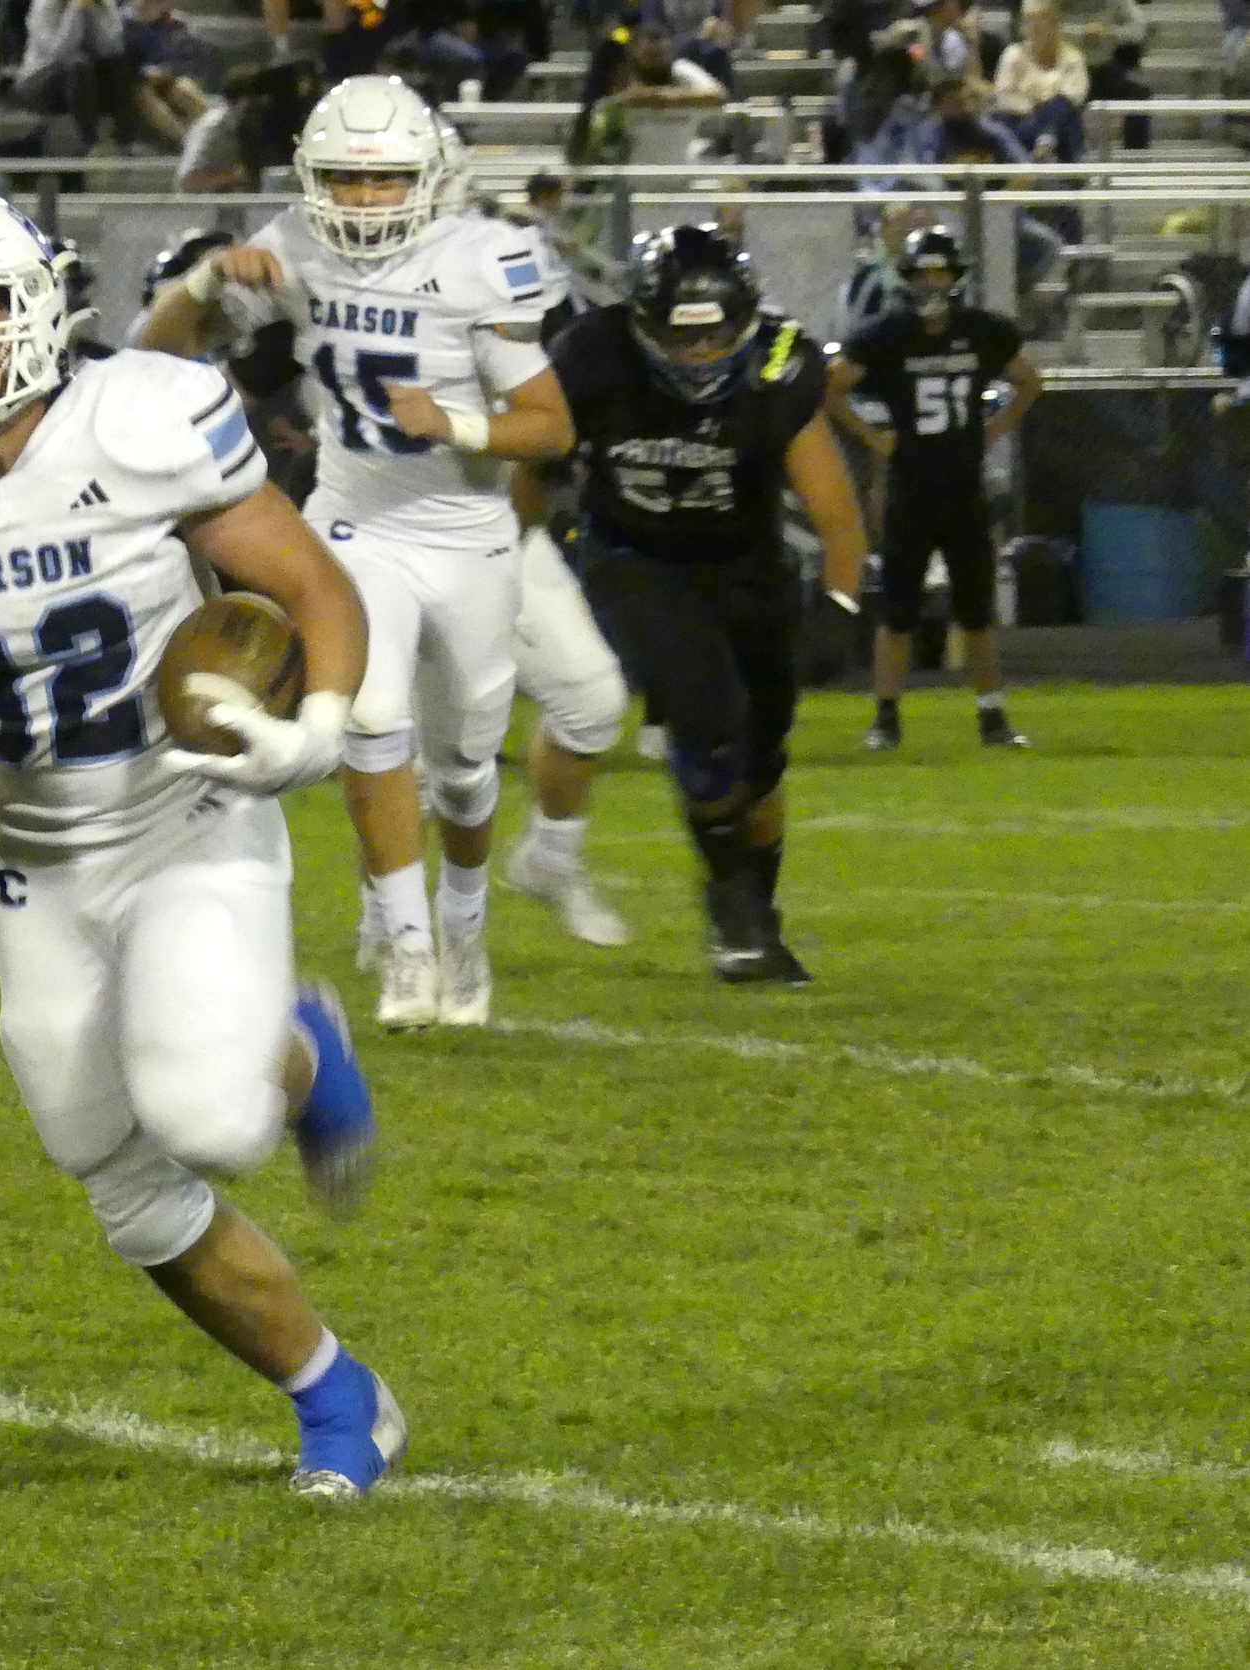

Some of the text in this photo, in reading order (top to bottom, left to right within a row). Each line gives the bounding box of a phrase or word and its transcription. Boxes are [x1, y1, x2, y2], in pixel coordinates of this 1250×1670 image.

[308, 298, 418, 338] CARSON
[312, 340, 431, 456] 15
[915, 376, 972, 435] 51
[329, 520, 354, 541] C
